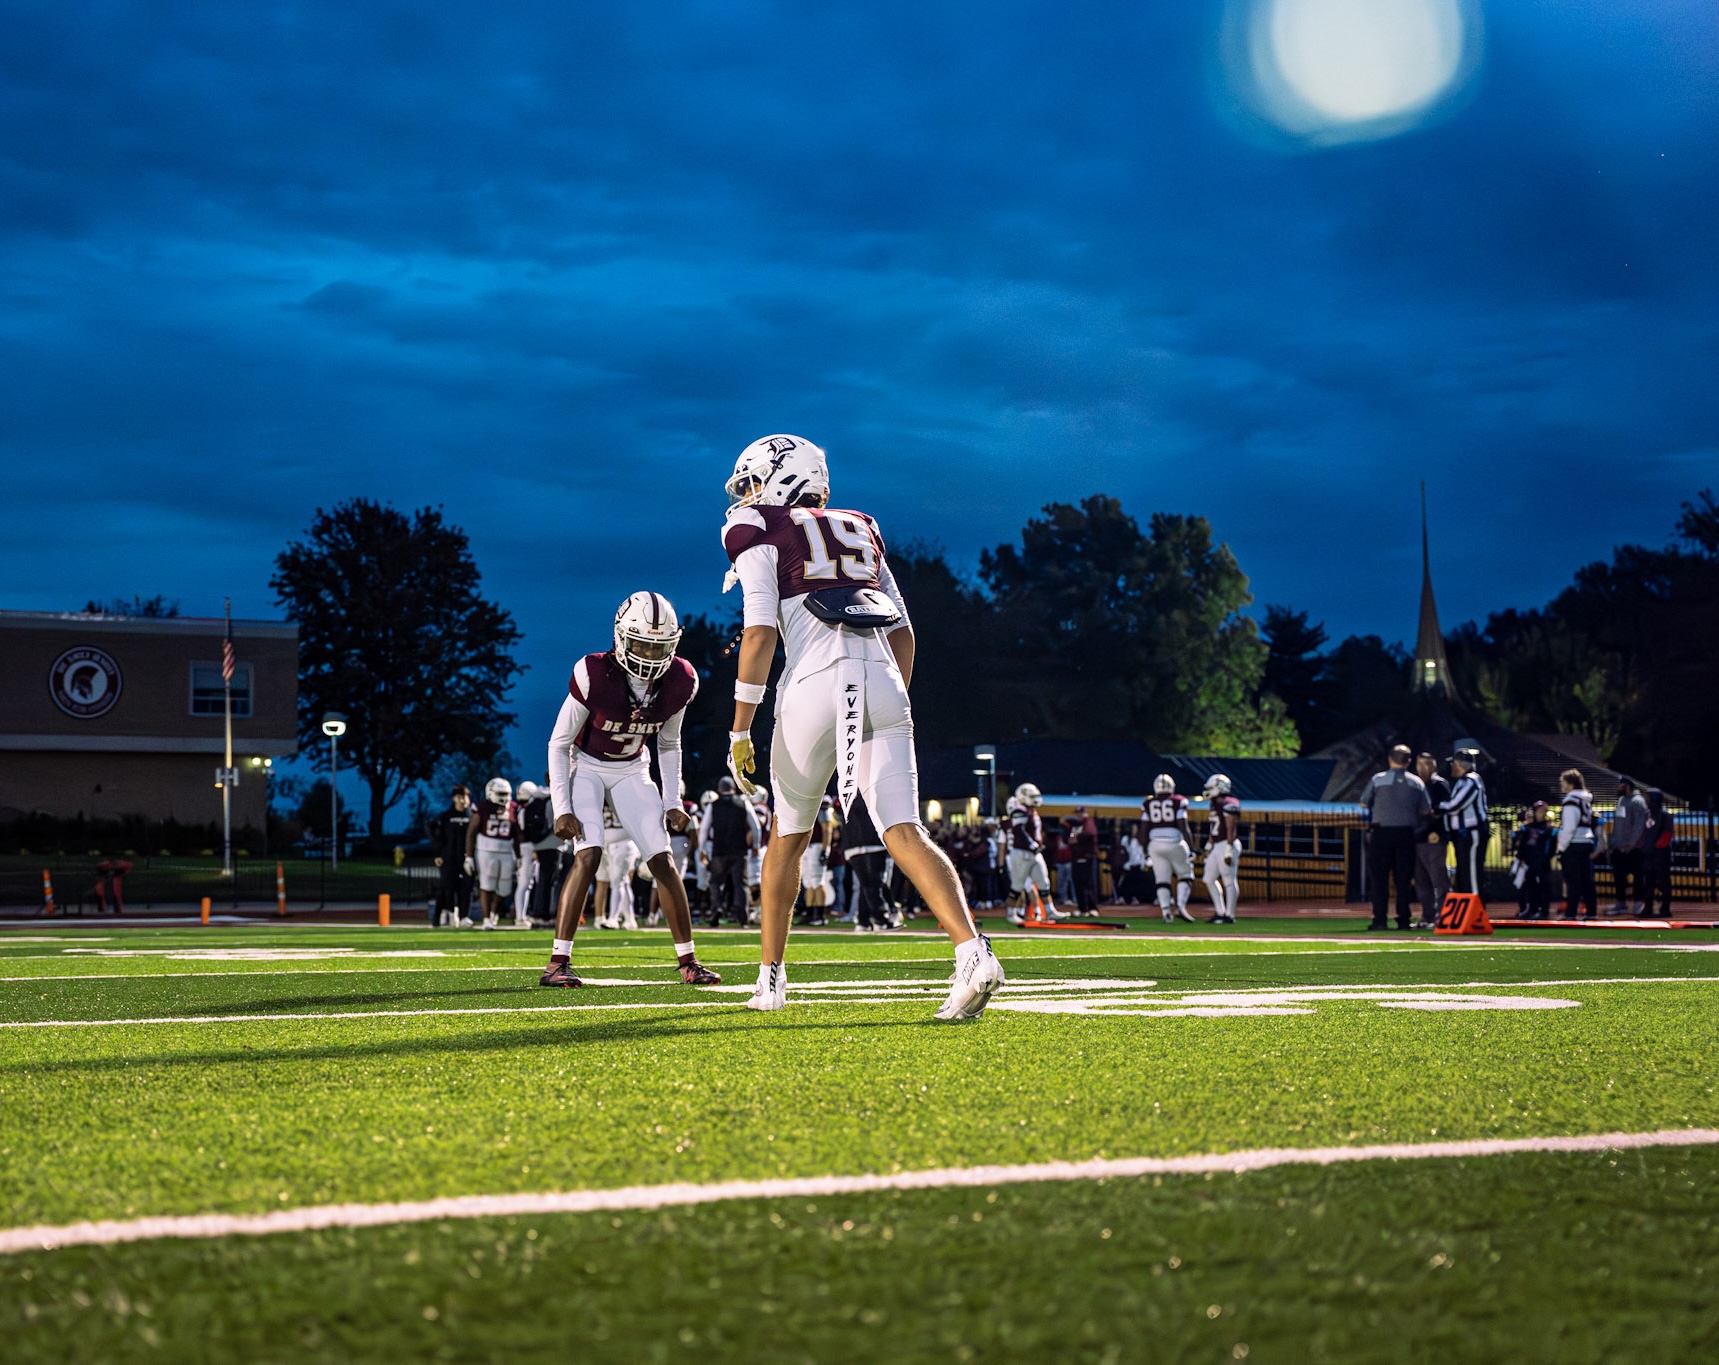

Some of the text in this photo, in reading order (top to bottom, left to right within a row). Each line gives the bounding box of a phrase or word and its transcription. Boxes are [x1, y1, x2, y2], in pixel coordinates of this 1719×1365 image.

[789, 507, 878, 581] 19
[601, 720, 664, 734] DE SMET
[844, 683, 859, 789] EVERYONE
[1149, 800, 1175, 823] 66
[1438, 898, 1470, 930] 20
[962, 951, 980, 986] NIKE
